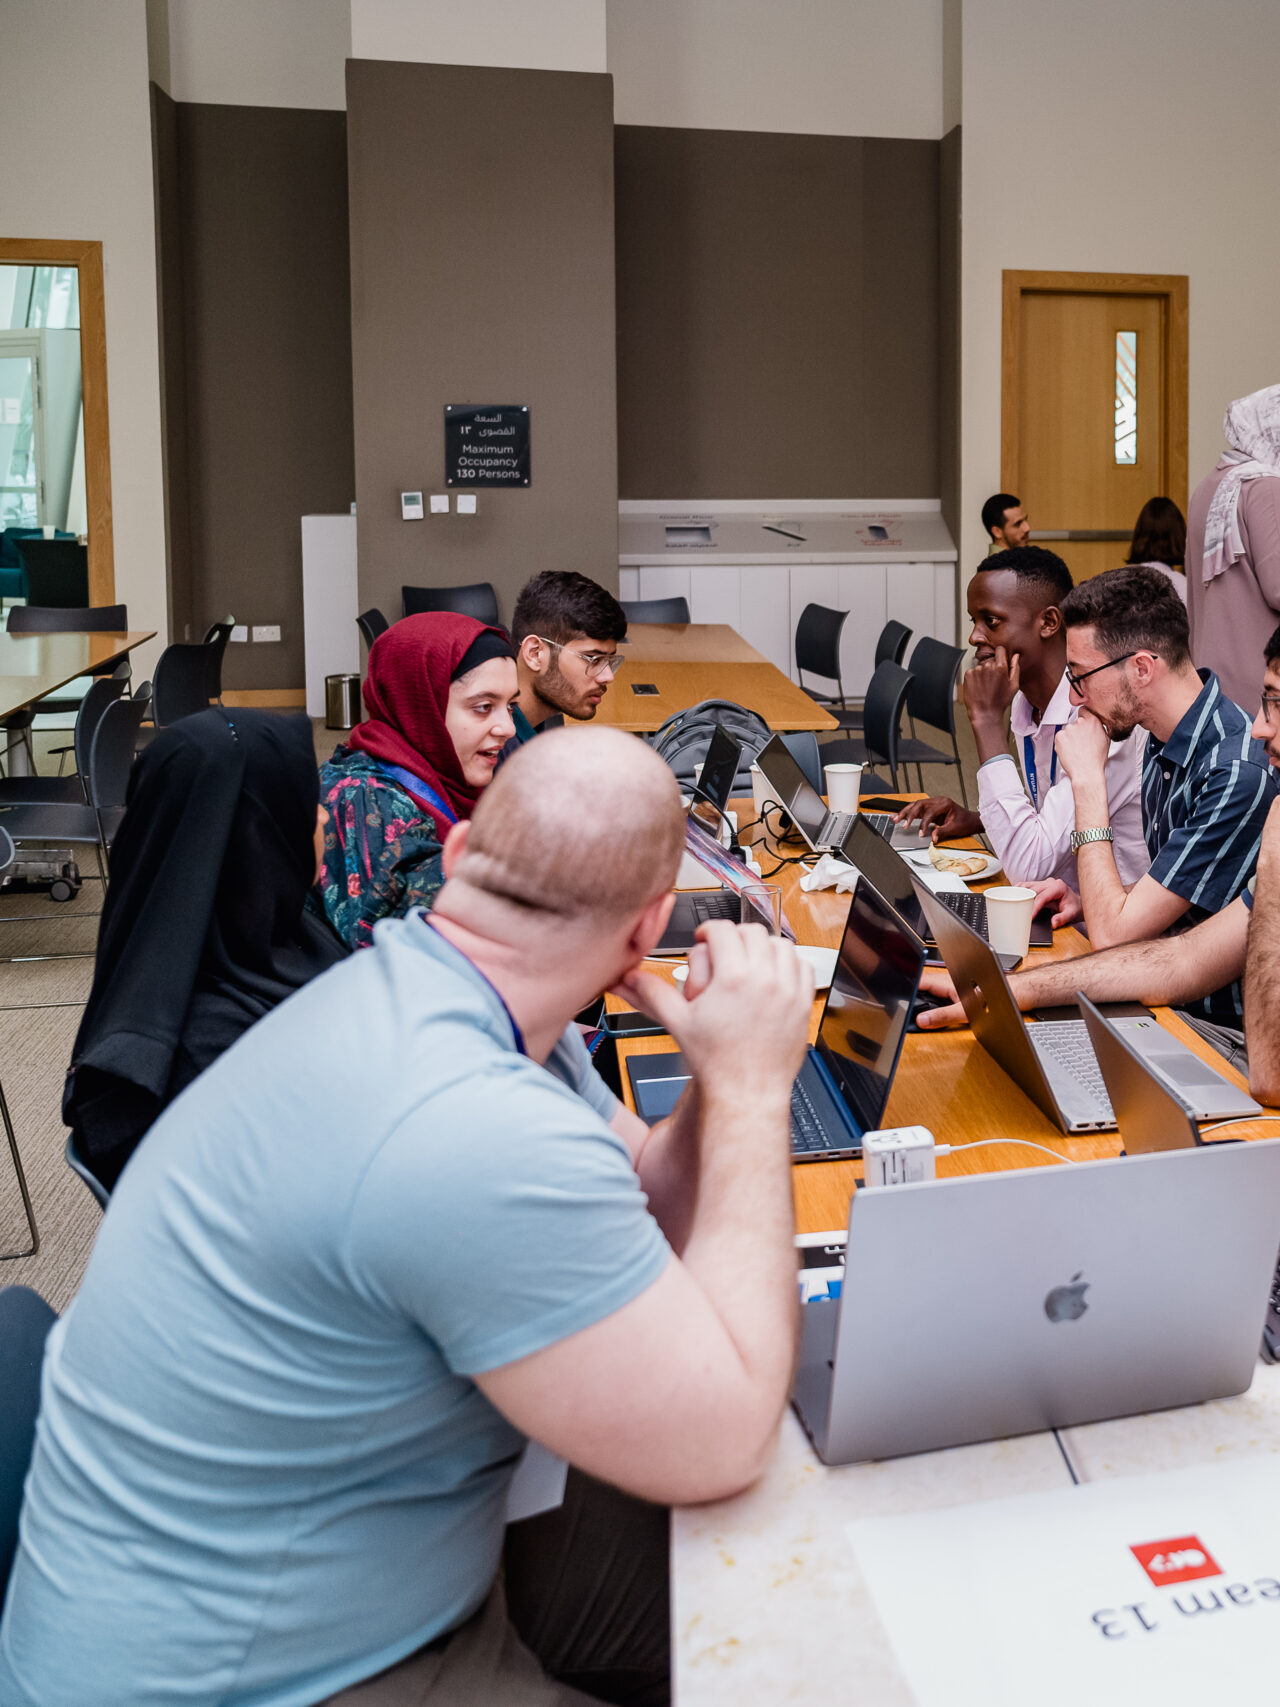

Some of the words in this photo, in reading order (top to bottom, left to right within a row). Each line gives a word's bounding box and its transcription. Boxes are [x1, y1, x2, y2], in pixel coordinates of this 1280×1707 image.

[474, 414, 502, 423] السعة
[478, 426, 515, 437] القصوى
[462, 444, 514, 454] Maximum
[458, 457, 518, 468] Occupancy
[456, 469, 476, 479] 130
[478, 469, 521, 479] Persons
[1089, 1599, 1159, 1641] 13
